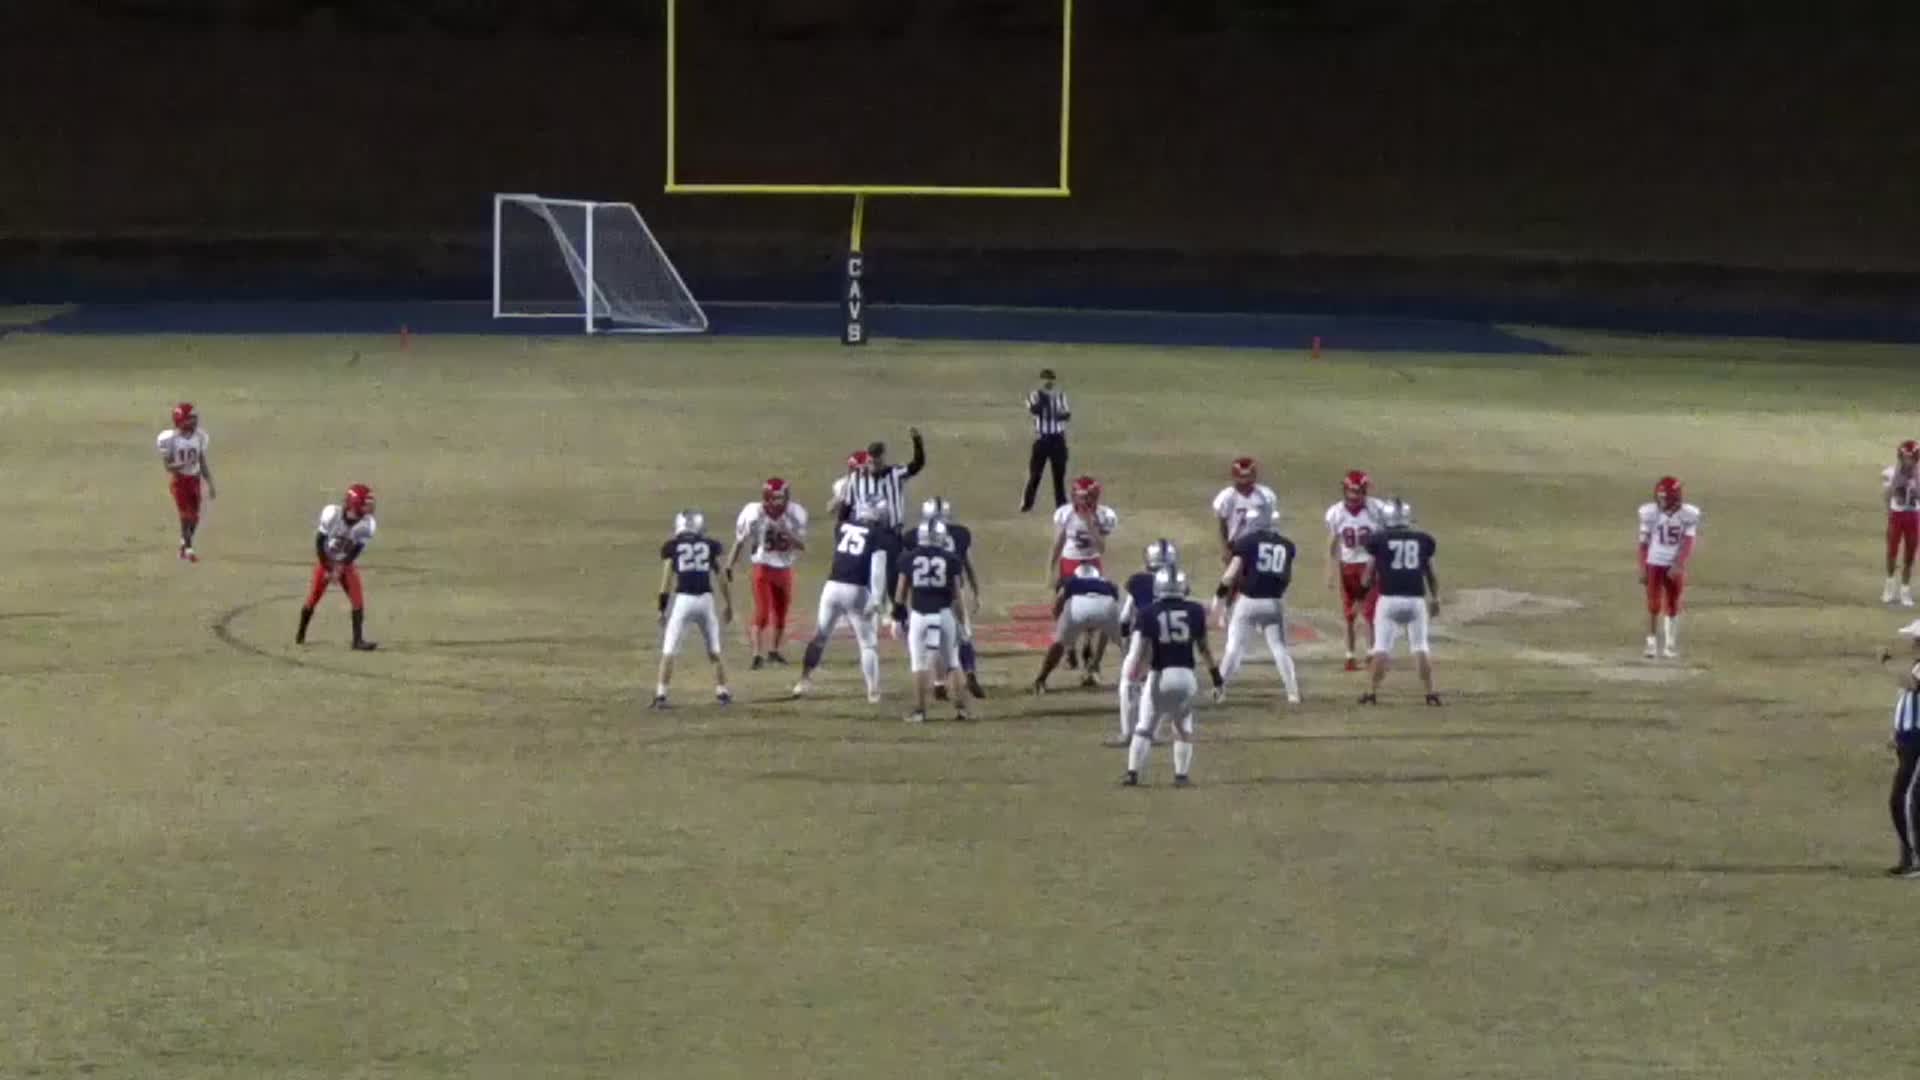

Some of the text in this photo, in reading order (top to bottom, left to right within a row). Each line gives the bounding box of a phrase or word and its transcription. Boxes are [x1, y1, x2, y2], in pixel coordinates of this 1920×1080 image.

[837, 523, 869, 555] 75
[1657, 524, 1681, 546] 15
[676, 541, 710, 572] 22
[1256, 542, 1286, 573] 50
[1387, 540, 1419, 569] 78
[912, 555, 947, 588] 23
[1157, 610, 1190, 643] 15
